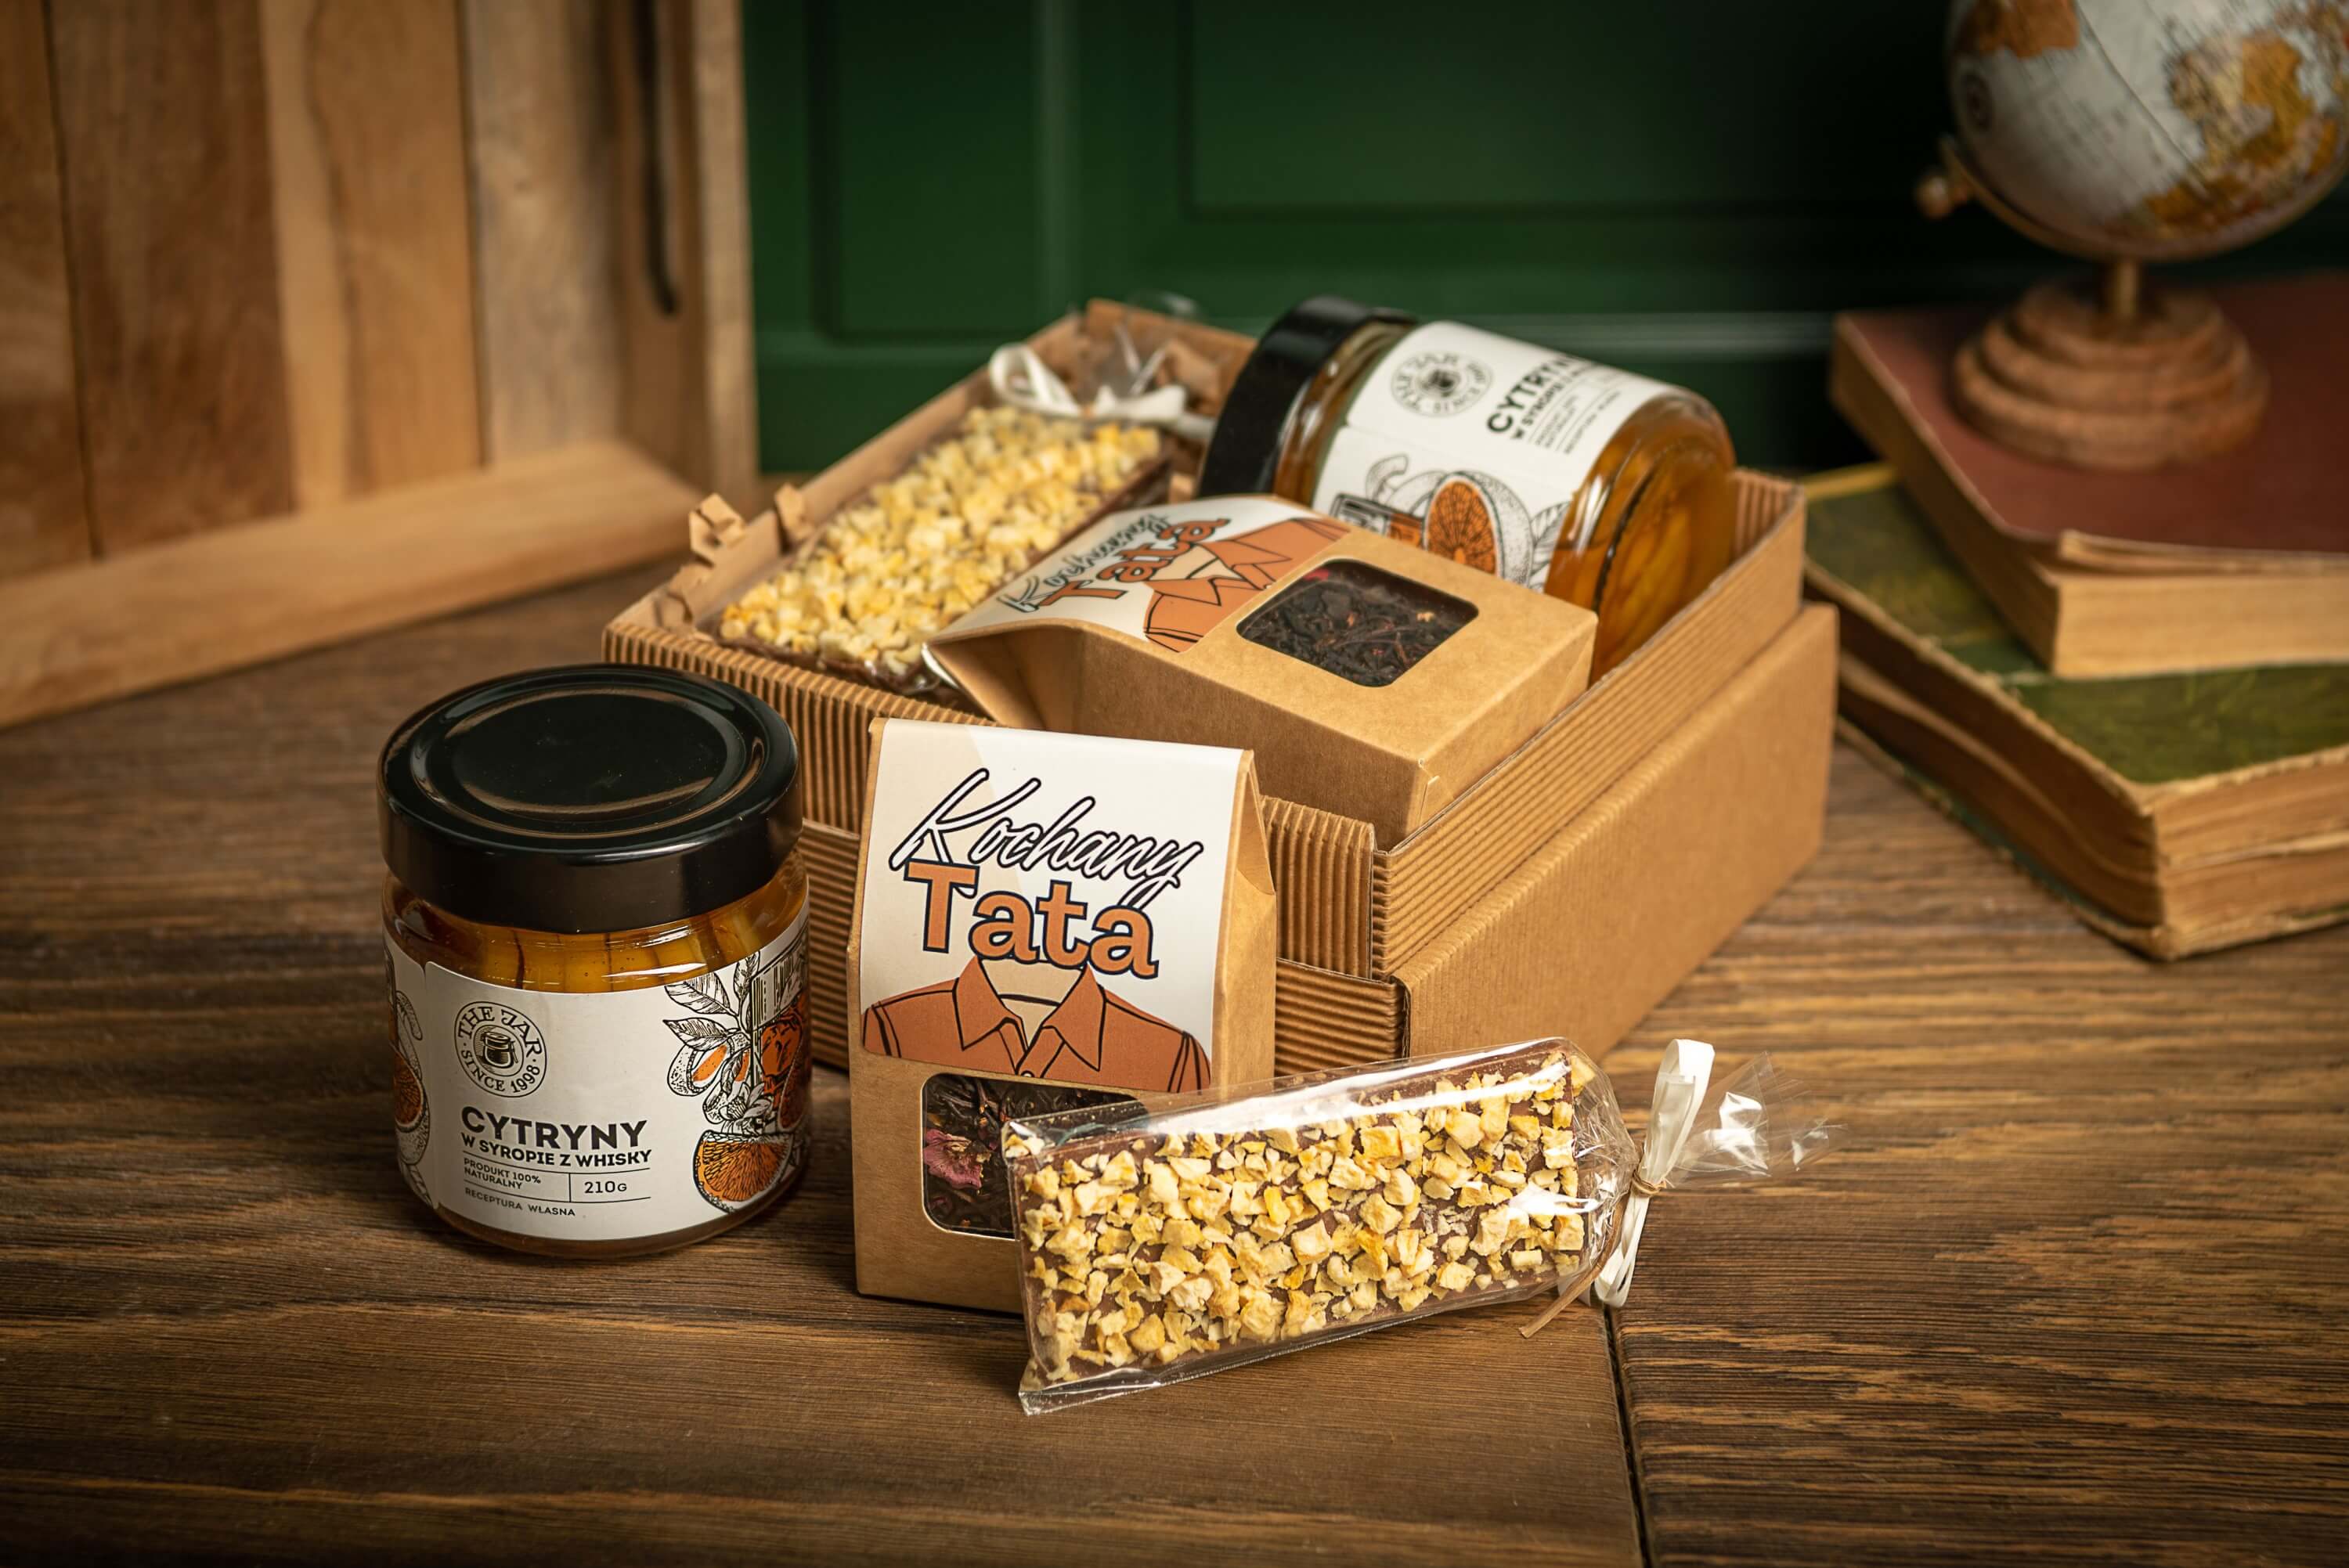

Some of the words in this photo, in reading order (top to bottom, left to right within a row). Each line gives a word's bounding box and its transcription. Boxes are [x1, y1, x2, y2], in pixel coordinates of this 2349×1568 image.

[1487, 356, 1568, 433] CYTRYN
[1038, 518, 1231, 607] Tata
[889, 768, 1203, 910] Kochany
[904, 858, 1160, 980] Tata
[457, 1006, 495, 1040] THE
[501, 1008, 543, 1058] JAR
[460, 1049, 506, 1092] SINCE
[511, 1065, 540, 1093] 1998
[461, 1106, 648, 1150] CYTRYNY
[461, 1133, 475, 1148] W
[479, 1140, 554, 1166] SYROPIE
[560, 1154, 571, 1166] Z
[576, 1149, 651, 1167] WHISKY
[464, 1158, 510, 1177] PRODUKT
[513, 1172, 541, 1184] 100%
[464, 1166, 522, 1190] NATURALNY
[465, 1188, 523, 1210] RECEPTURA
